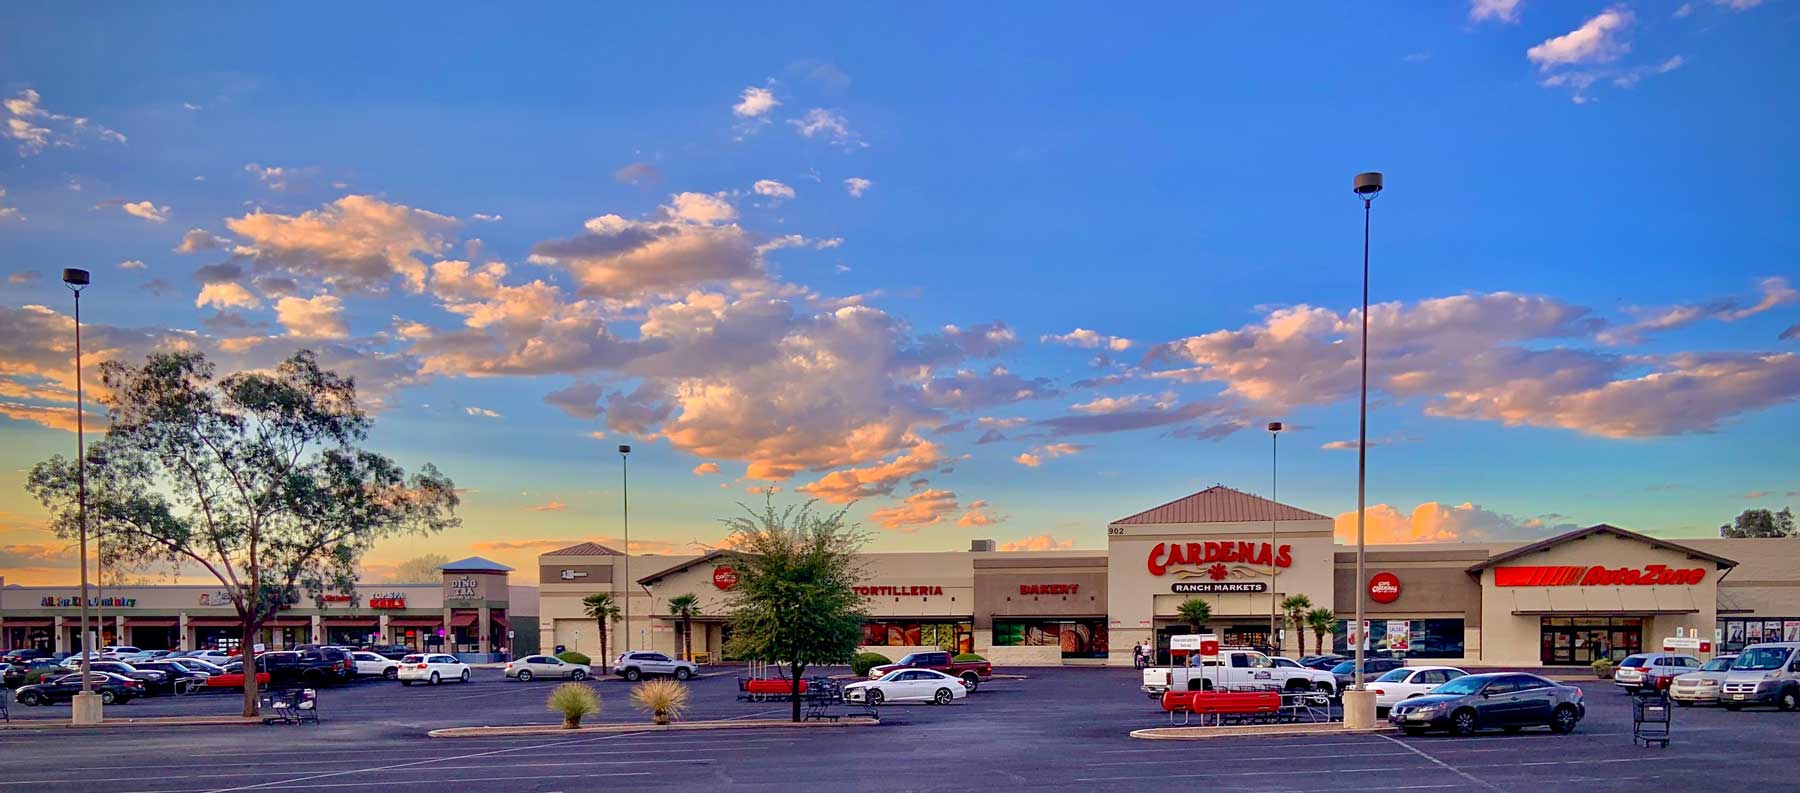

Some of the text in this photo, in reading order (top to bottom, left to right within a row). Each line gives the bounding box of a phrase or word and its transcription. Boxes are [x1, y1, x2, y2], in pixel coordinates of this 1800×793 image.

[1108, 527, 1125, 535] 902
[1147, 541, 1292, 577] CARDENAS
[1580, 564, 1706, 586] AutoZone
[852, 586, 943, 597] TORTILLERIA
[1020, 584, 1080, 596] BAKERY
[1176, 583, 1262, 592] RANCH MARKETS
